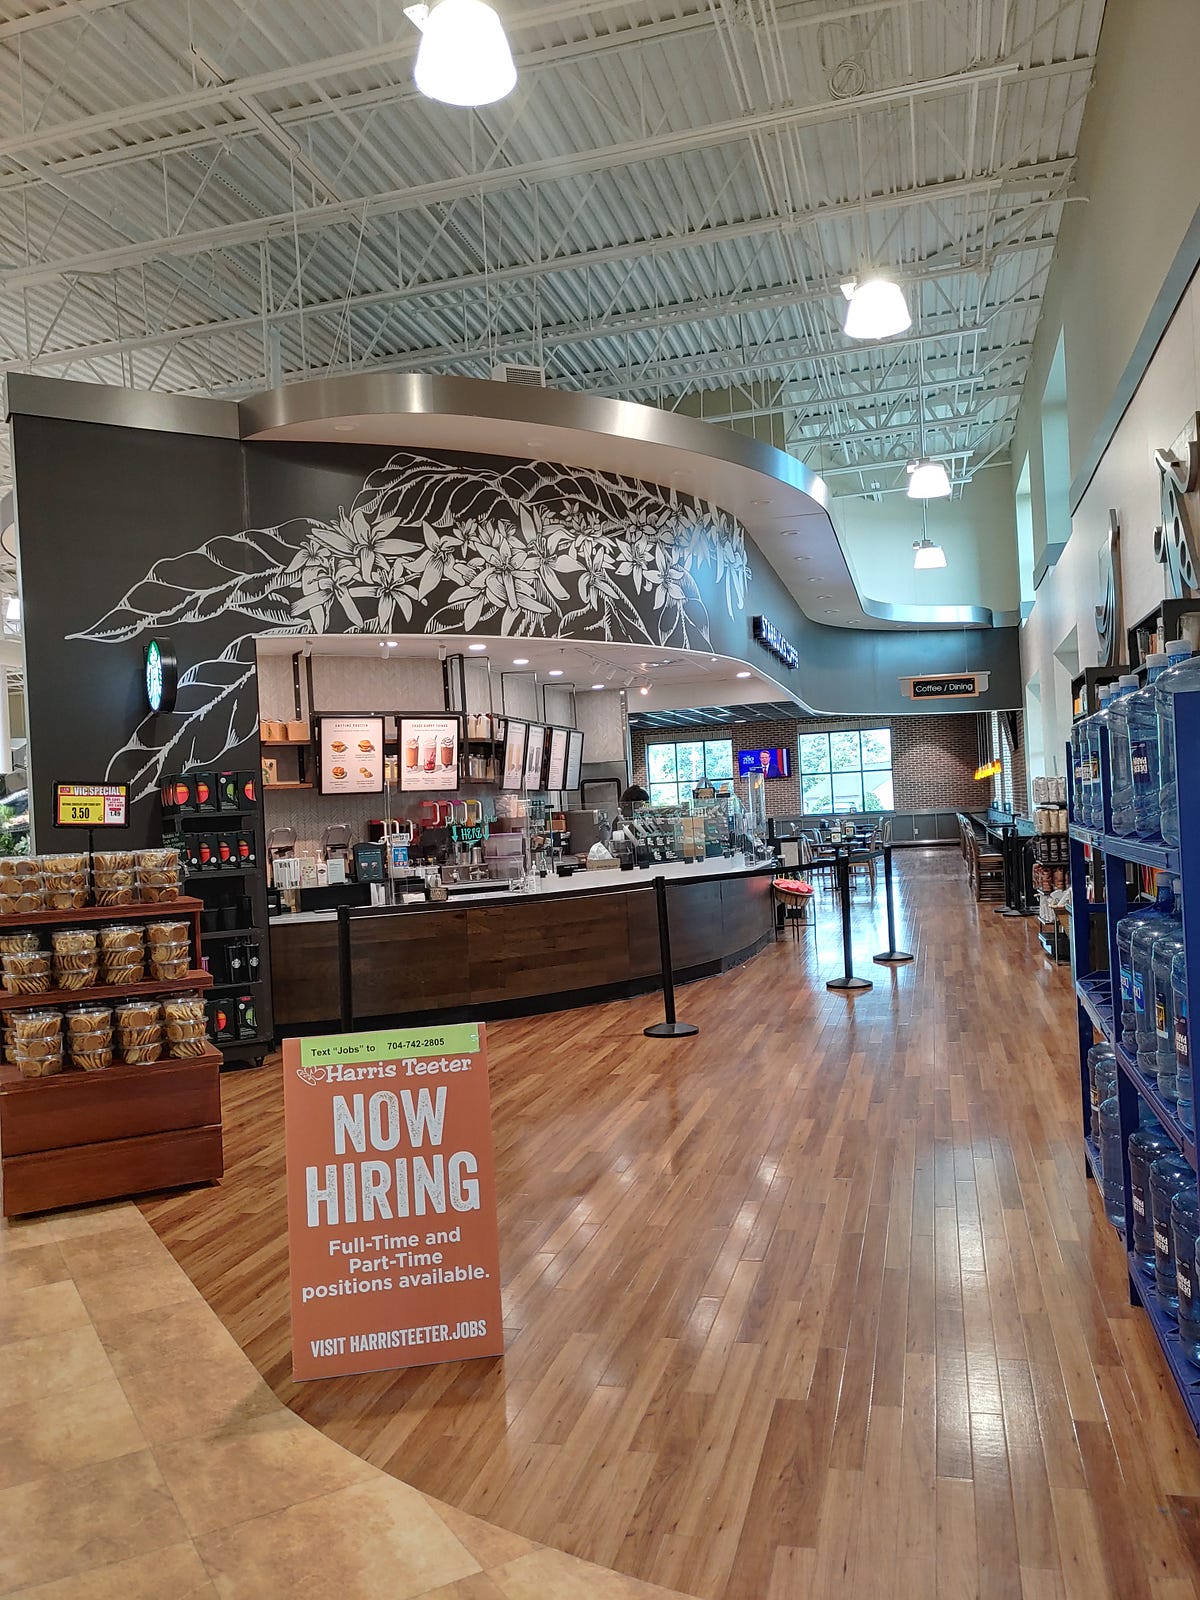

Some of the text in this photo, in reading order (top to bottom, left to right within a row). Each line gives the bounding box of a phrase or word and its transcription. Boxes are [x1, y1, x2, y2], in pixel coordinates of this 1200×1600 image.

[915, 685, 942, 693] Coffee
[949, 683, 974, 691] Dining
[74, 786, 88, 795] VIC
[89, 786, 120, 795] SPECIAL
[72, 807, 90, 819] 3.50
[461, 827, 482, 840] HERE
[311, 1038, 445, 1057] Text "Jobs" to 704-742-2805
[326, 1057, 471, 1083] Harris Teeter
[333, 1086, 447, 1155] NOW
[306, 1151, 481, 1227] HIRING
[329, 1226, 461, 1256] Full-Time and
[349, 1251, 443, 1274] Part-Time
[302, 1264, 490, 1303] positions available.
[310, 1319, 487, 1358] VISIT HARRISTEETER.JOBS
